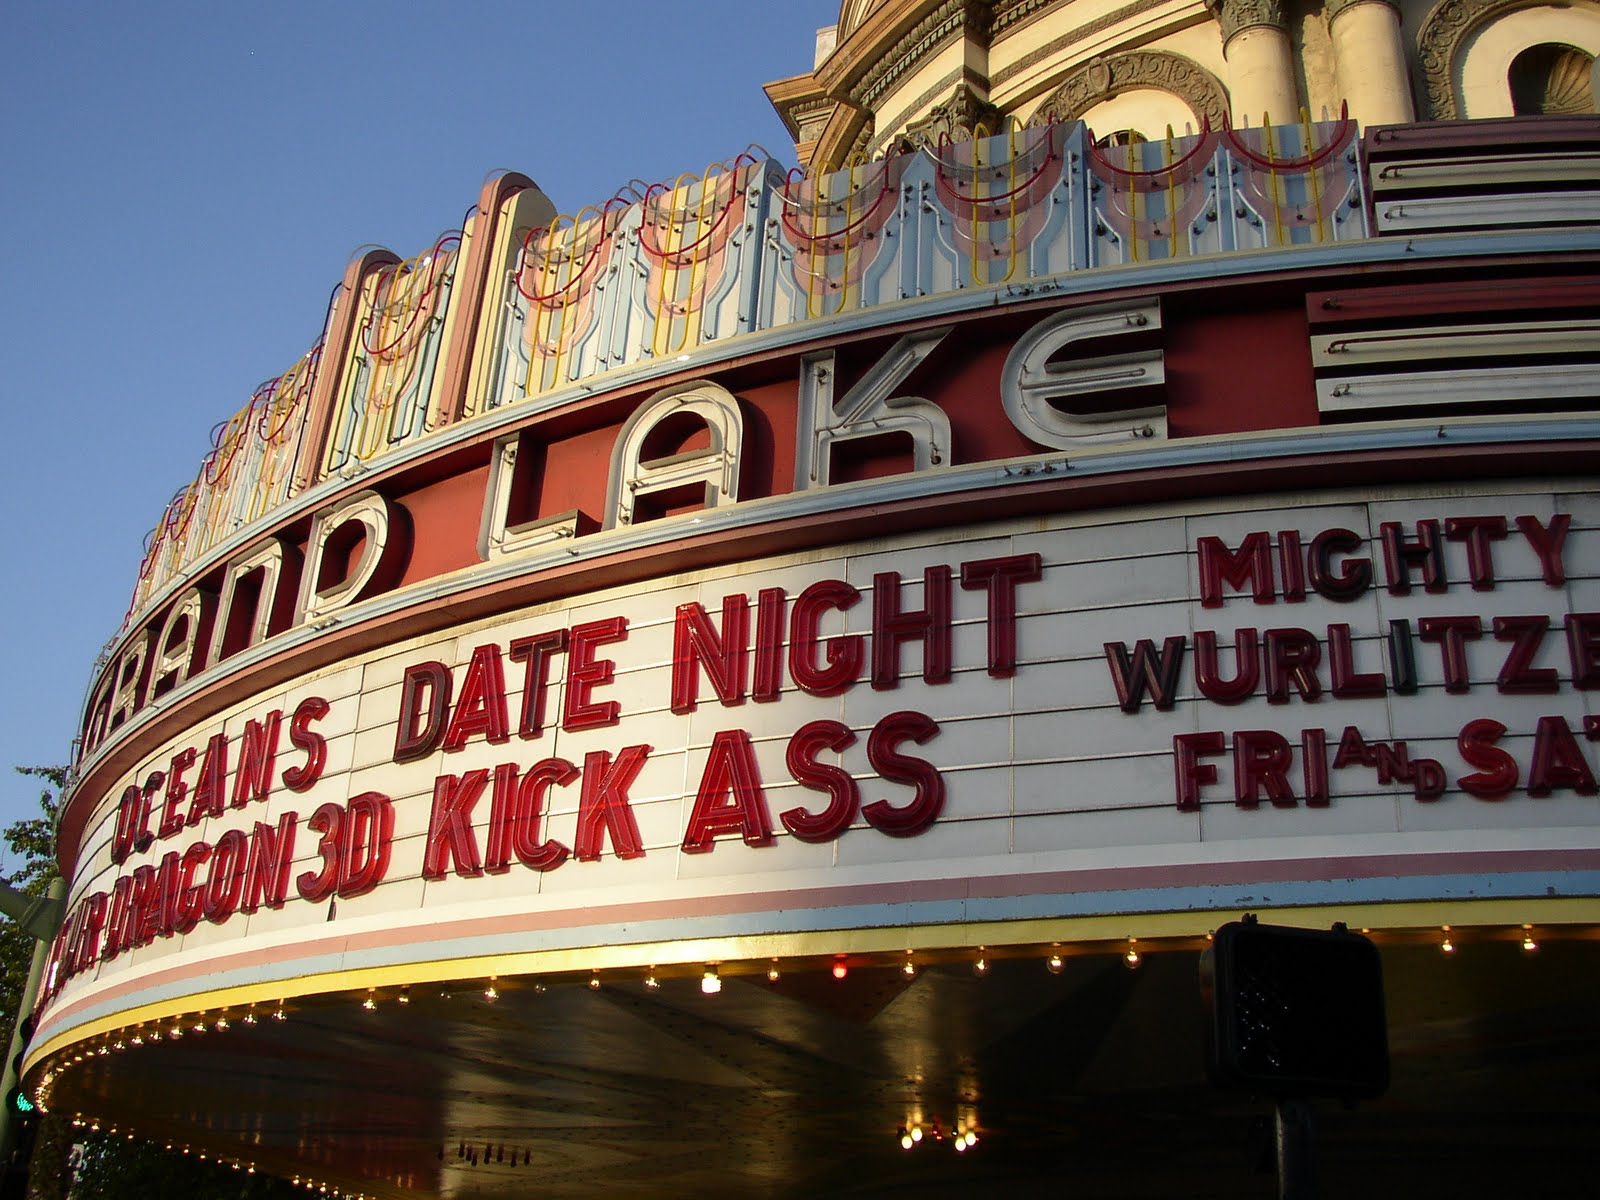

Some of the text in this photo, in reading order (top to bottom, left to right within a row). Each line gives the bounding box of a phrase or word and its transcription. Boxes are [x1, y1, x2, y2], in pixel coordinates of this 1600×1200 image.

[477, 296, 1169, 561] LAKE
[1196, 513, 1572, 609] MIGHTY
[393, 552, 1043, 764] DATE NIGHT
[111, 696, 331, 865] OCEANS
[422, 710, 946, 881] KICK ASS
[1173, 727, 1331, 813] FRI
[1332, 725, 1447, 803] AND
[101, 811, 299, 963] DRAGON
[296, 790, 395, 903] 3D
